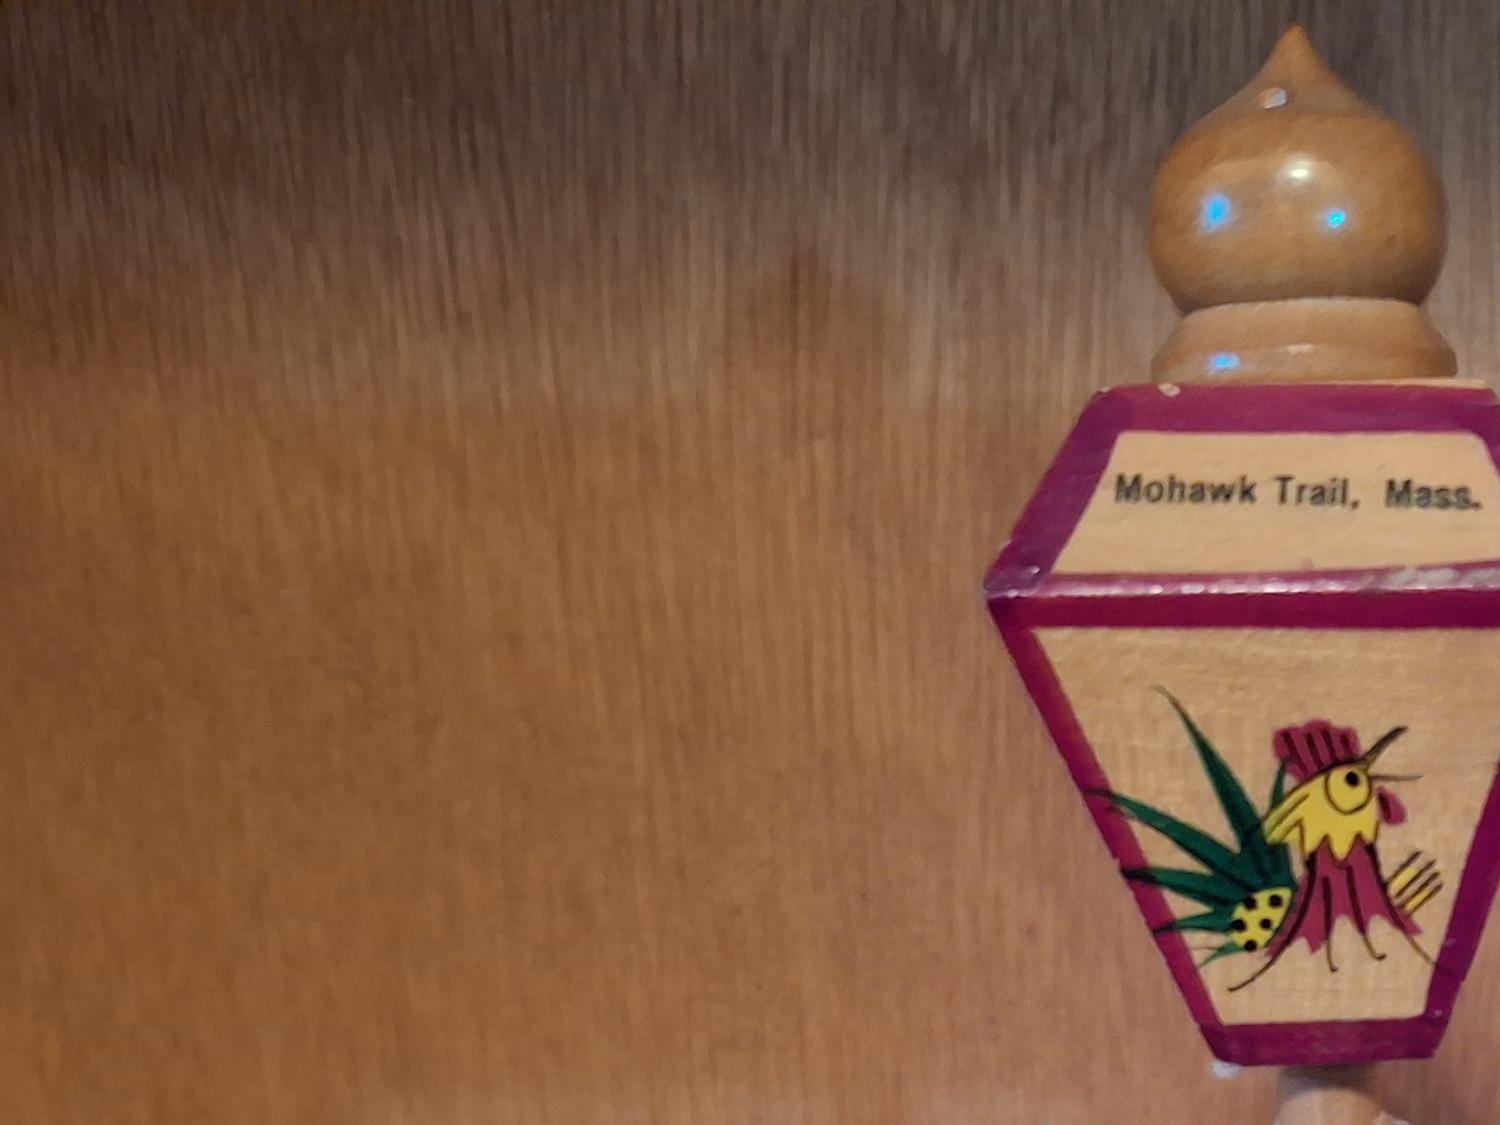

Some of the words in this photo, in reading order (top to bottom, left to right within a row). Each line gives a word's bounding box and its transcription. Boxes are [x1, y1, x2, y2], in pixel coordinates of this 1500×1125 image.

[1114, 473, 1258, 505] Mohawk
[1274, 475, 1361, 511] Trail,
[1385, 478, 1483, 510] Mass.
